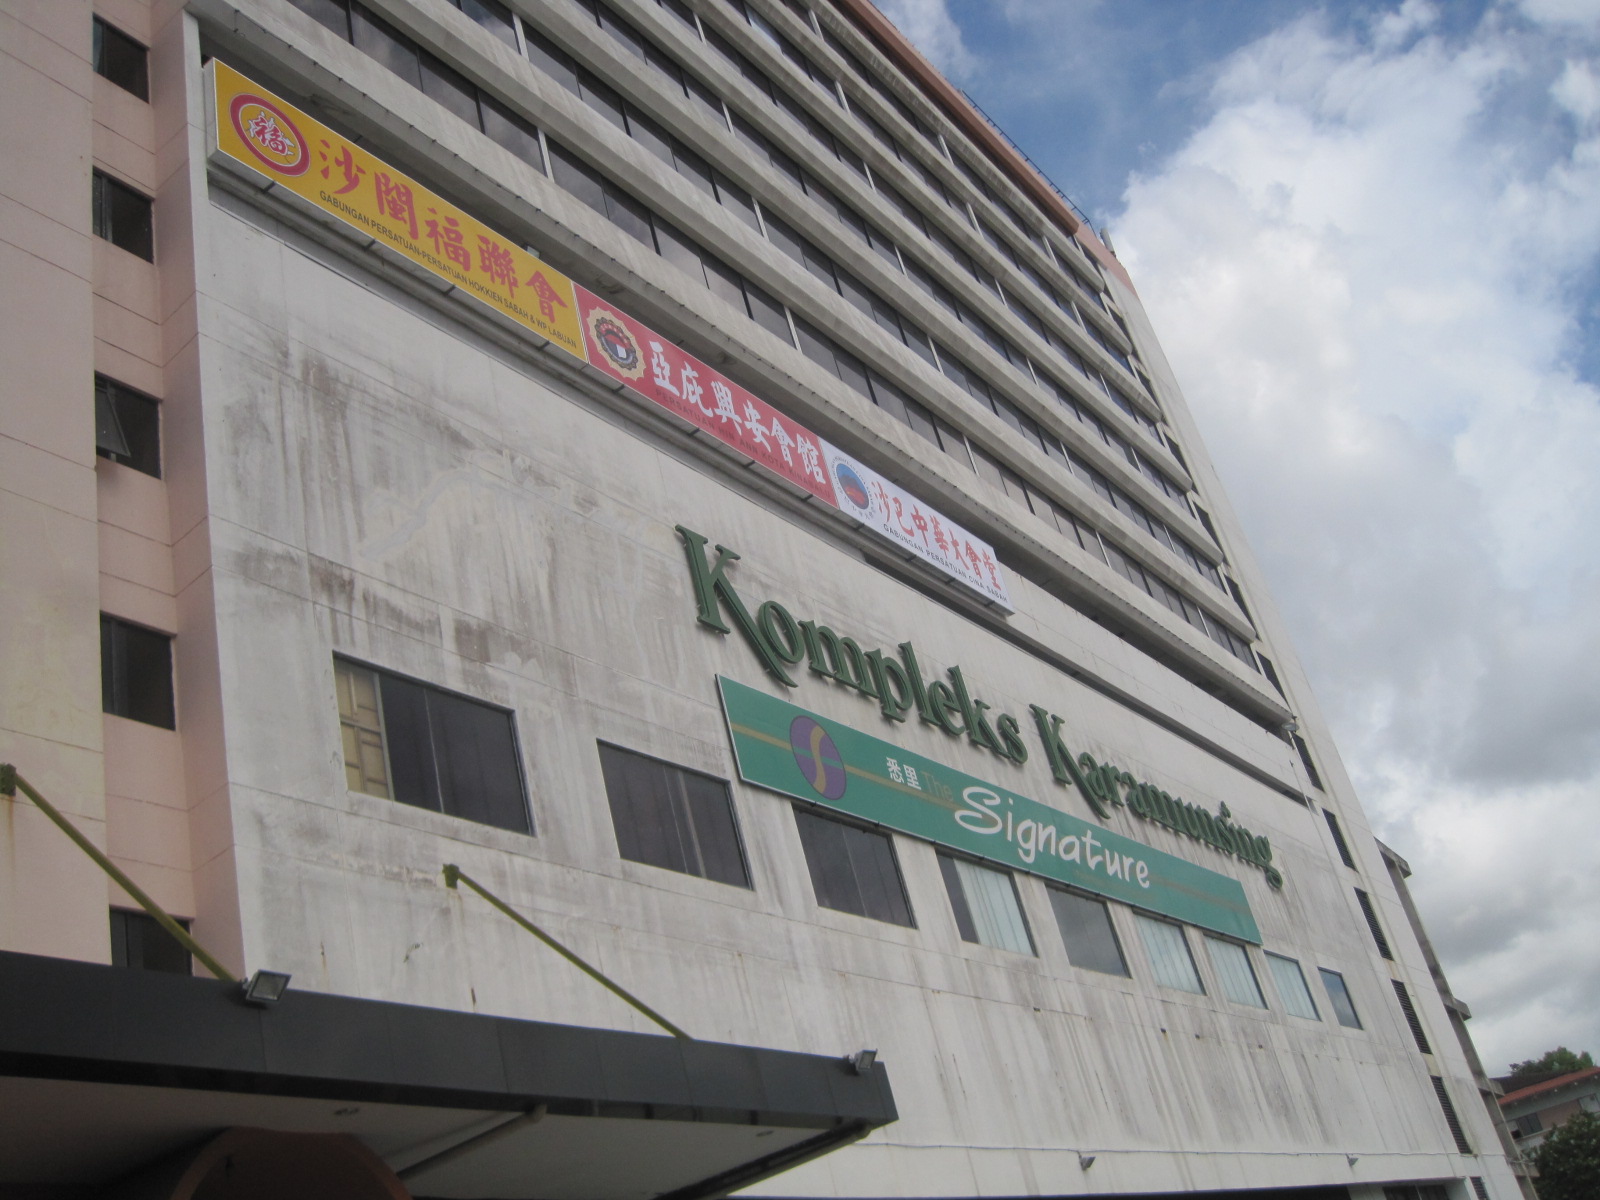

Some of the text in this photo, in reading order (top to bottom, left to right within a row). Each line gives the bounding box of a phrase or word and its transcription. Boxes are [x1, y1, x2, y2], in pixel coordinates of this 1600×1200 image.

[318, 139, 569, 325] 沙閩福聯會
[319, 189, 370, 227] GABUNGAN
[468, 277, 503, 304] HOKKIEN
[503, 298, 529, 320] SABAH
[547, 326, 577, 349] LABUAN
[655, 388, 715, 430] PERSATUAN
[760, 450, 785, 471] KOTA
[883, 523, 1008, 603] GABUNGAN PERSATUAN CINA SABAH
[675, 524, 1283, 889] Kompleks Karamunsing
[954, 785, 1151, 889] Signature
